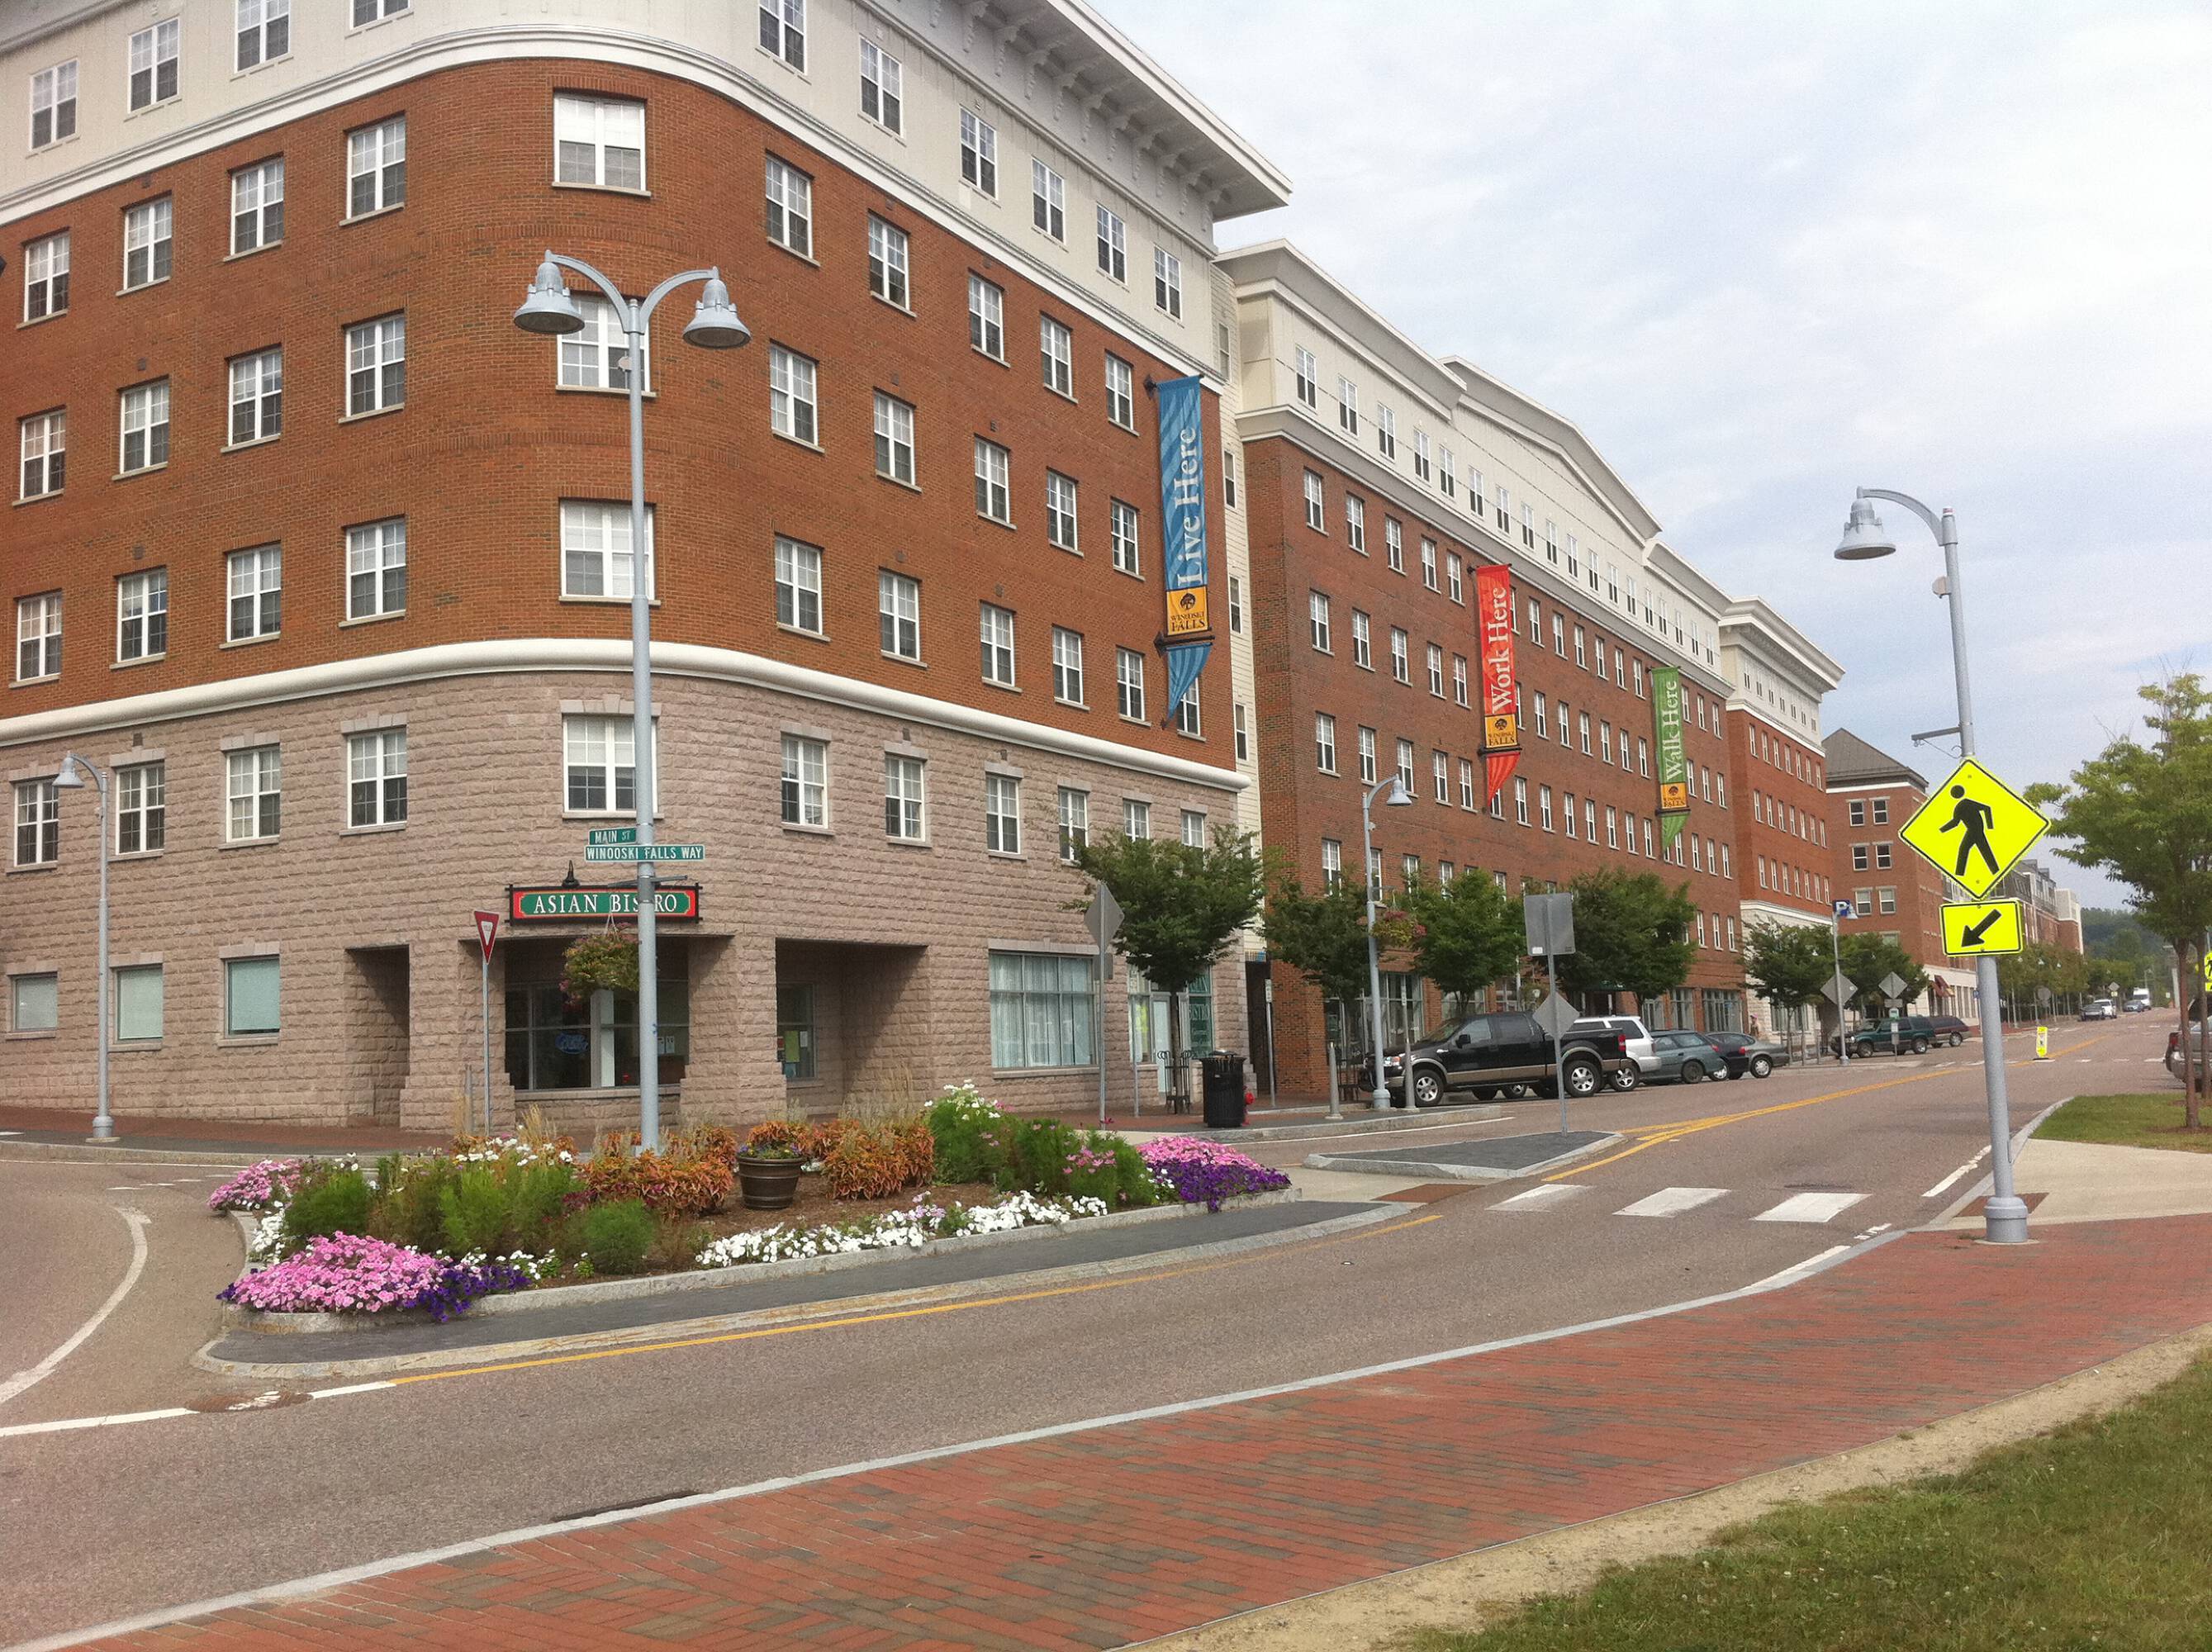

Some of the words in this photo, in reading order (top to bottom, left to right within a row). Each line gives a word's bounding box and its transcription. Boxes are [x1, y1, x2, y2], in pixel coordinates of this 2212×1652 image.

[1174, 427, 1200, 509] Here
[1176, 515, 1203, 586] Live
[1171, 620, 1206, 633] FALLS
[1488, 587, 1508, 643] Here
[1488, 648, 1512, 714] Work
[1661, 681, 1679, 727] Here
[1662, 730, 1683, 781] Walk
[586, 847, 638, 860] WINOOSKI
[644, 847, 676, 860] FALLS
[681, 847, 701, 859] WAY
[595, 830, 617, 843] MAIN
[621, 830, 630, 841] ST
[533, 894, 598, 914] ASIAN
[610, 894, 677, 913] BISRO
